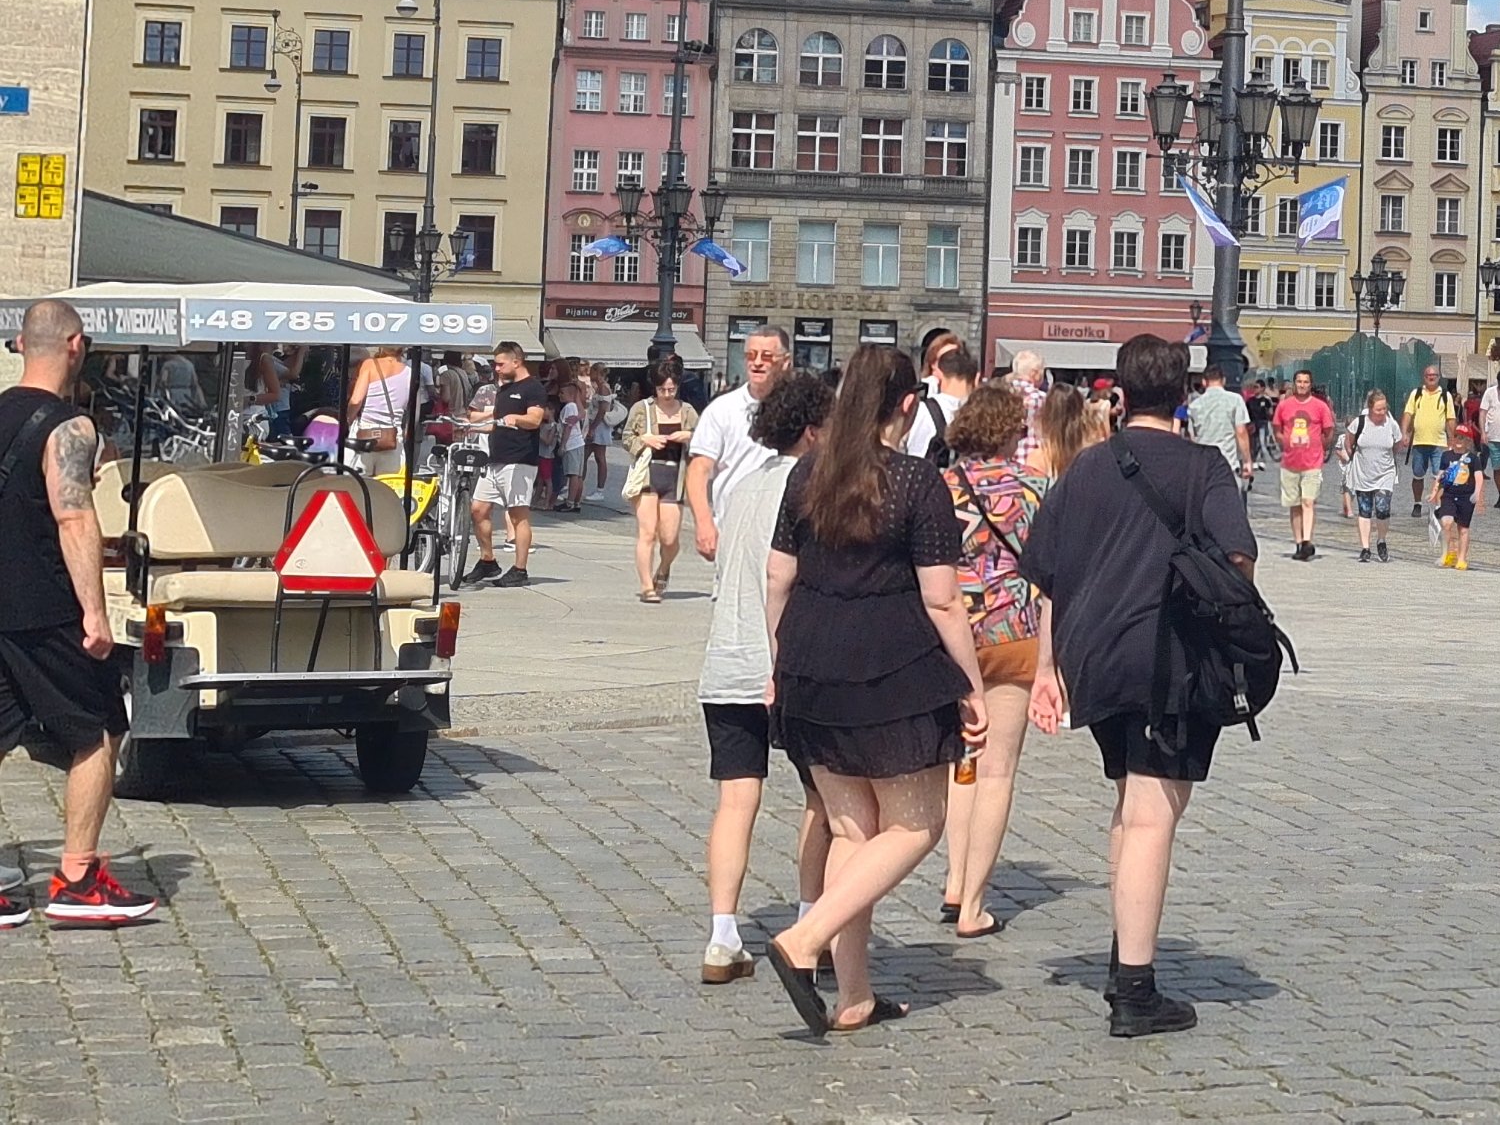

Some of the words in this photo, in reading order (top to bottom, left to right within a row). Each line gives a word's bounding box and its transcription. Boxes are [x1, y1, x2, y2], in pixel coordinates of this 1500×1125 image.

[738, 291, 888, 312] BIBLIOTEKA
[190, 309, 253, 330] +48
[264, 311, 335, 332] 785
[348, 312, 408, 333] 107
[419, 313, 488, 334] 999
[565, 308, 597, 317] Pijalnia
[643, 310, 687, 319] Czeady
[1048, 325, 1105, 338] Literatka
